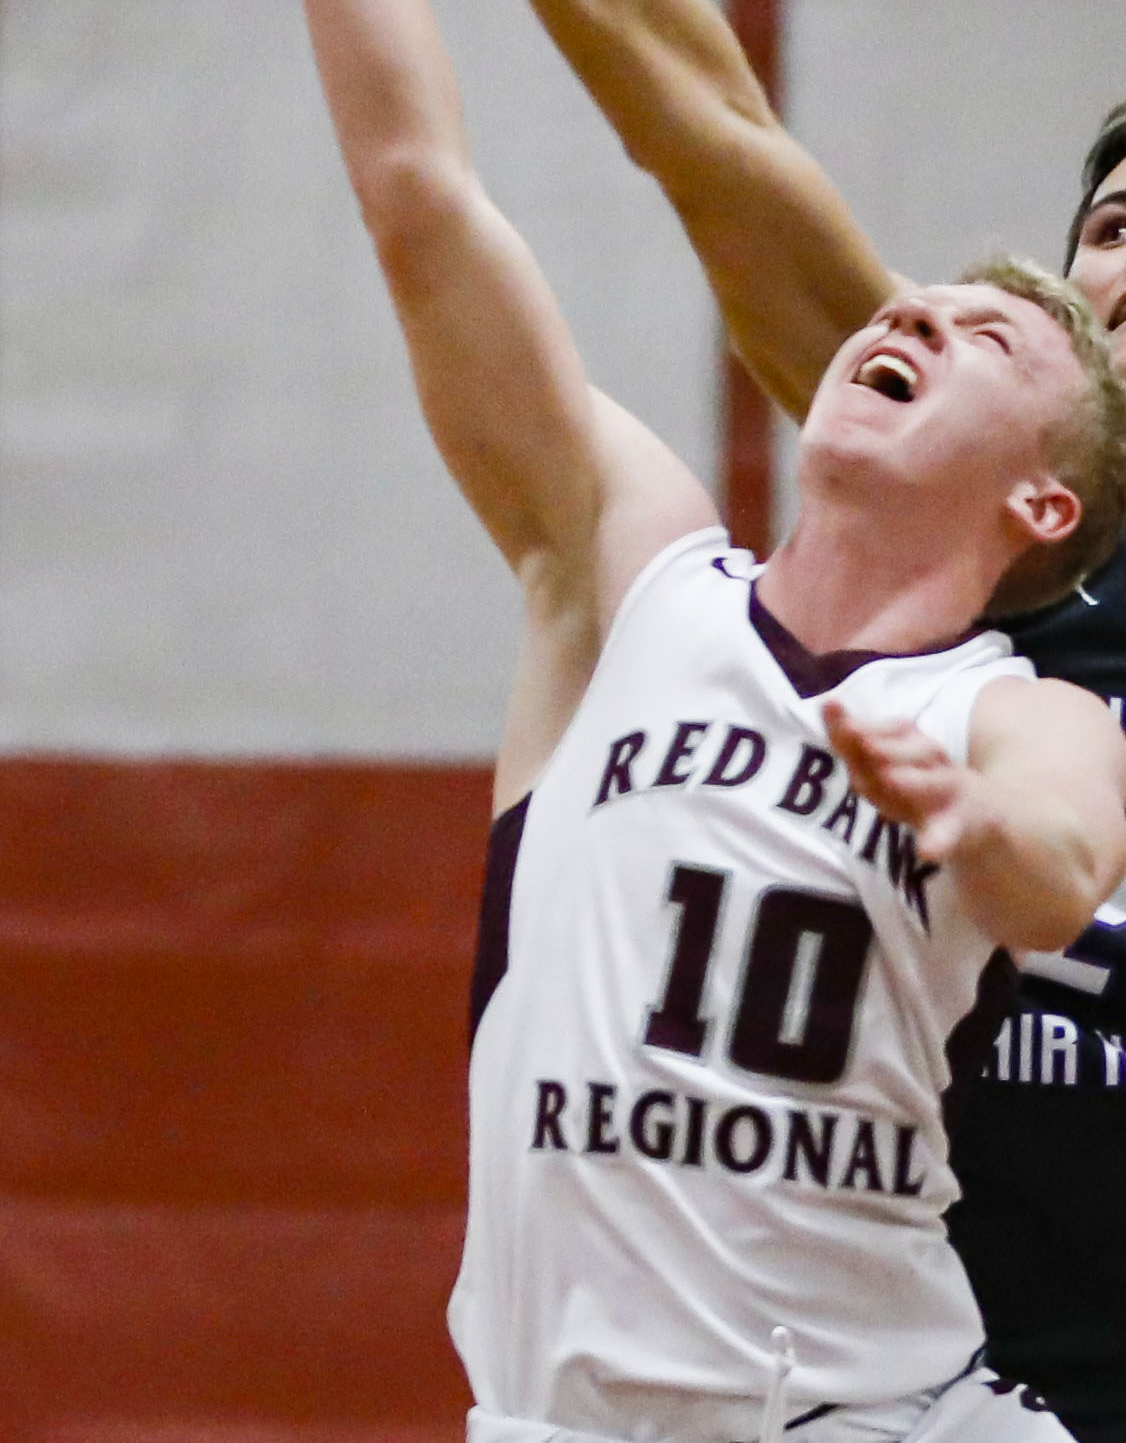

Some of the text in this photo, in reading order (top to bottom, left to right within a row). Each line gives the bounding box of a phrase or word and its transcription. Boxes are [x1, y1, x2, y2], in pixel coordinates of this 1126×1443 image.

[593, 720, 767, 809] RED
[643, 863, 875, 1085] 10
[981, 1012, 1079, 1086] AIR
[531, 1079, 928, 1198] REGIONAL
